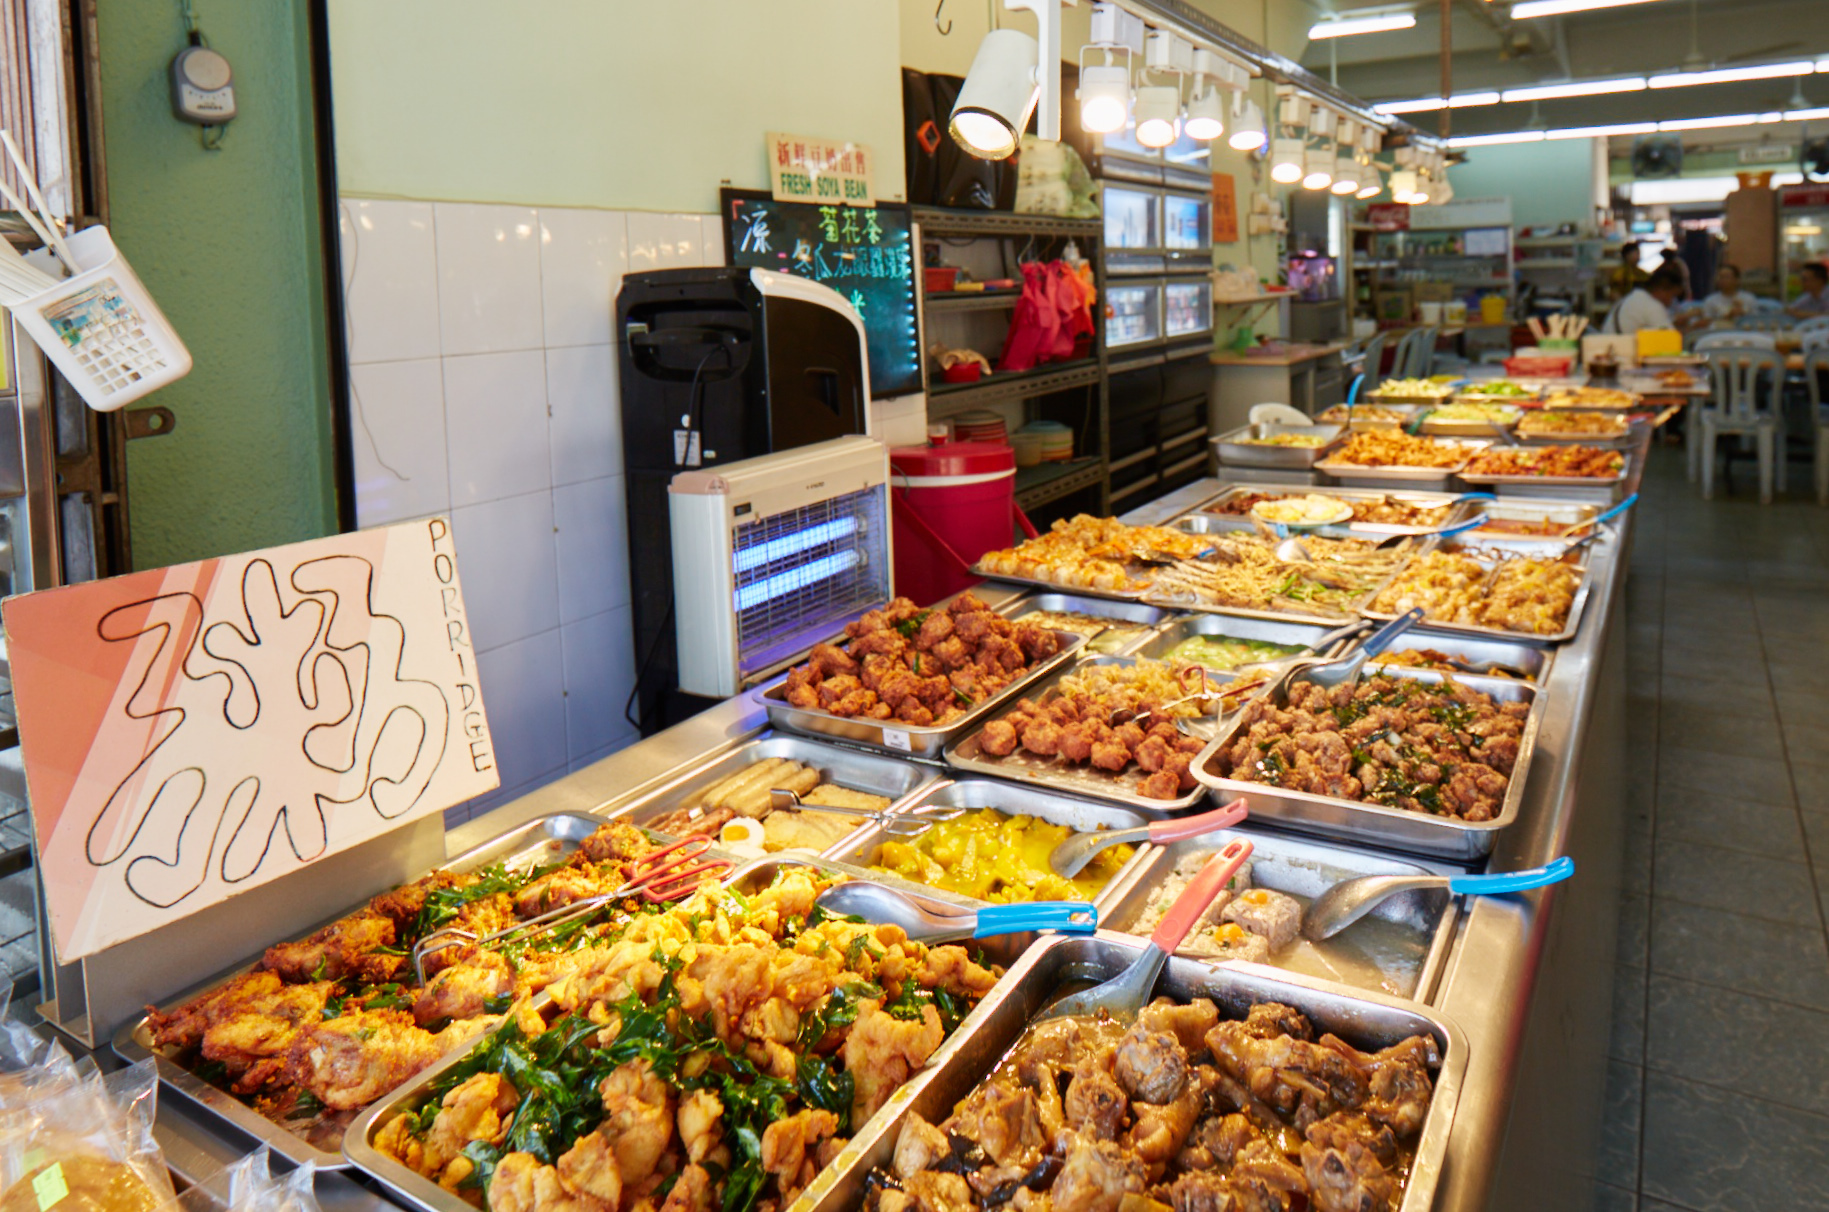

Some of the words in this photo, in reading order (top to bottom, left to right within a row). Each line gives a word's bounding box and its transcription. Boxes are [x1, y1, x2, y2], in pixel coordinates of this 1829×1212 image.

[780, 172, 813, 196] FRESH
[816, 176, 841, 198] SOYA
[844, 178, 868, 200] BEAN
[86, 554, 450, 908] 粥
[427, 518, 493, 773] PORRIDGE
